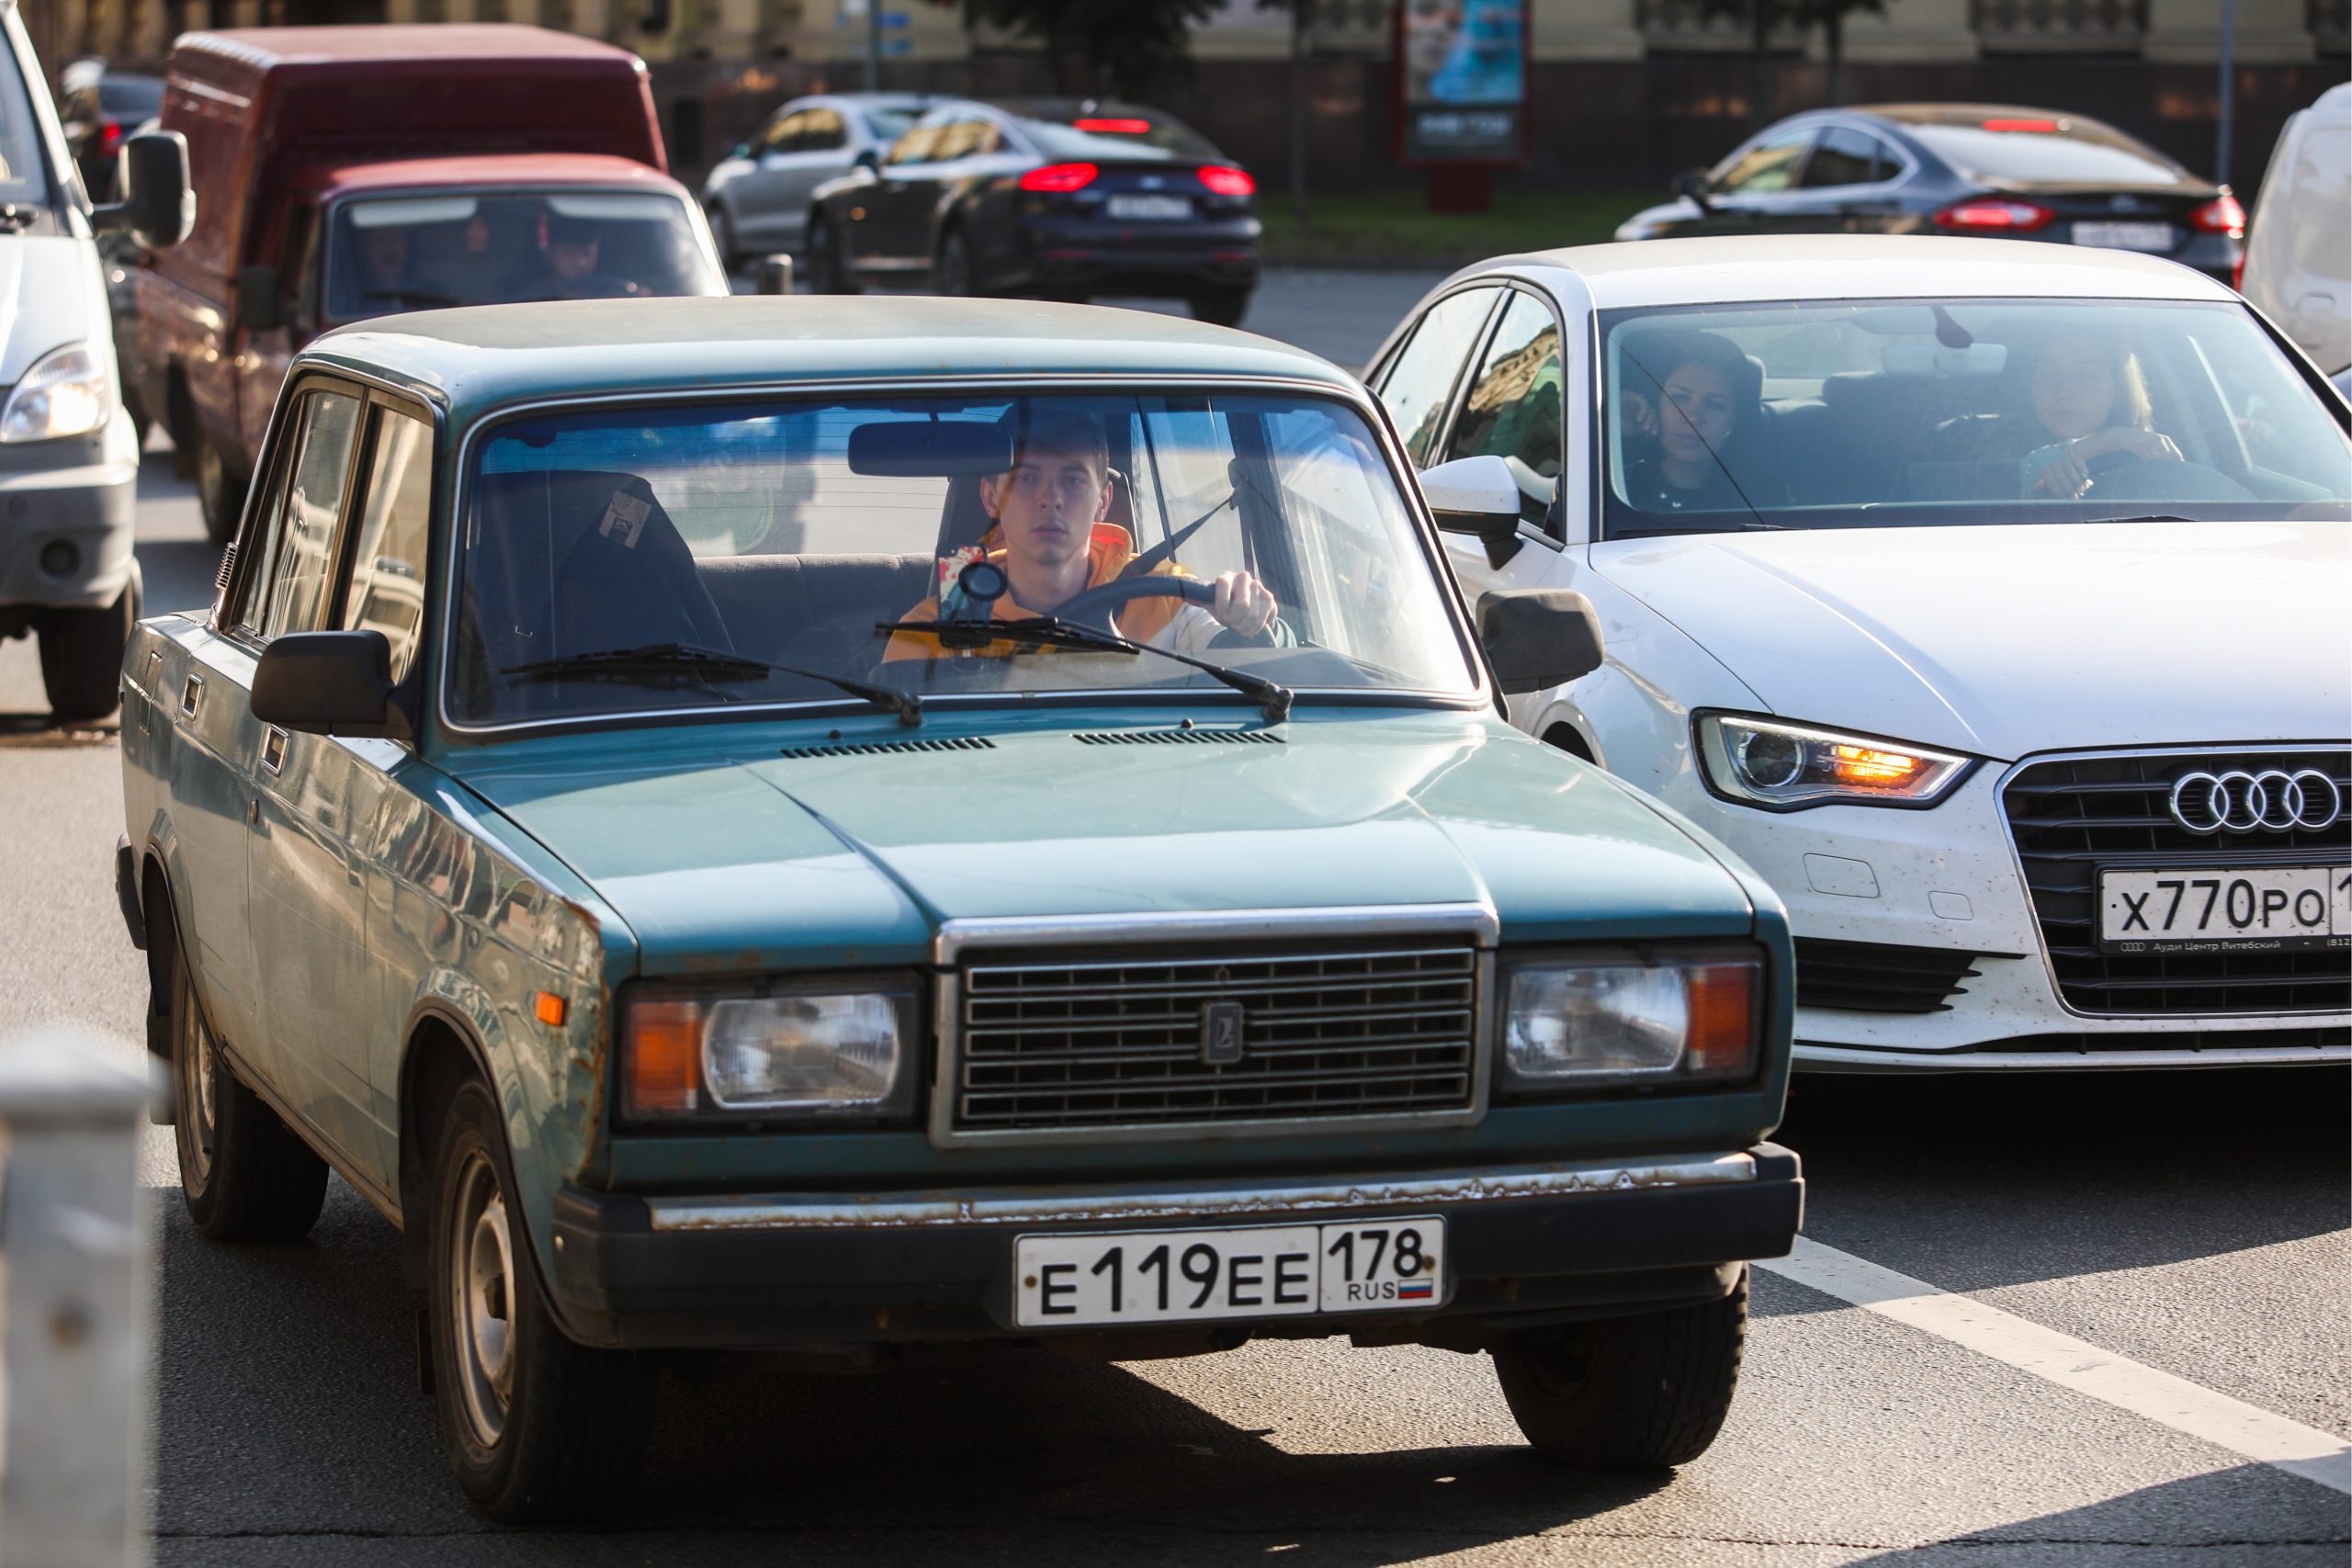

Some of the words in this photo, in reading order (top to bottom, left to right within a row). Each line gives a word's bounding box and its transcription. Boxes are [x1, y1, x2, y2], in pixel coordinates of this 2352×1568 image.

[2153, 942, 2182, 952] Ауди
[2184, 942, 2220, 952] Центр
[2221, 940, 2281, 950] Витебский
[1328, 1228, 1423, 1281] 178
[1347, 1280, 1396, 1302] RUS
